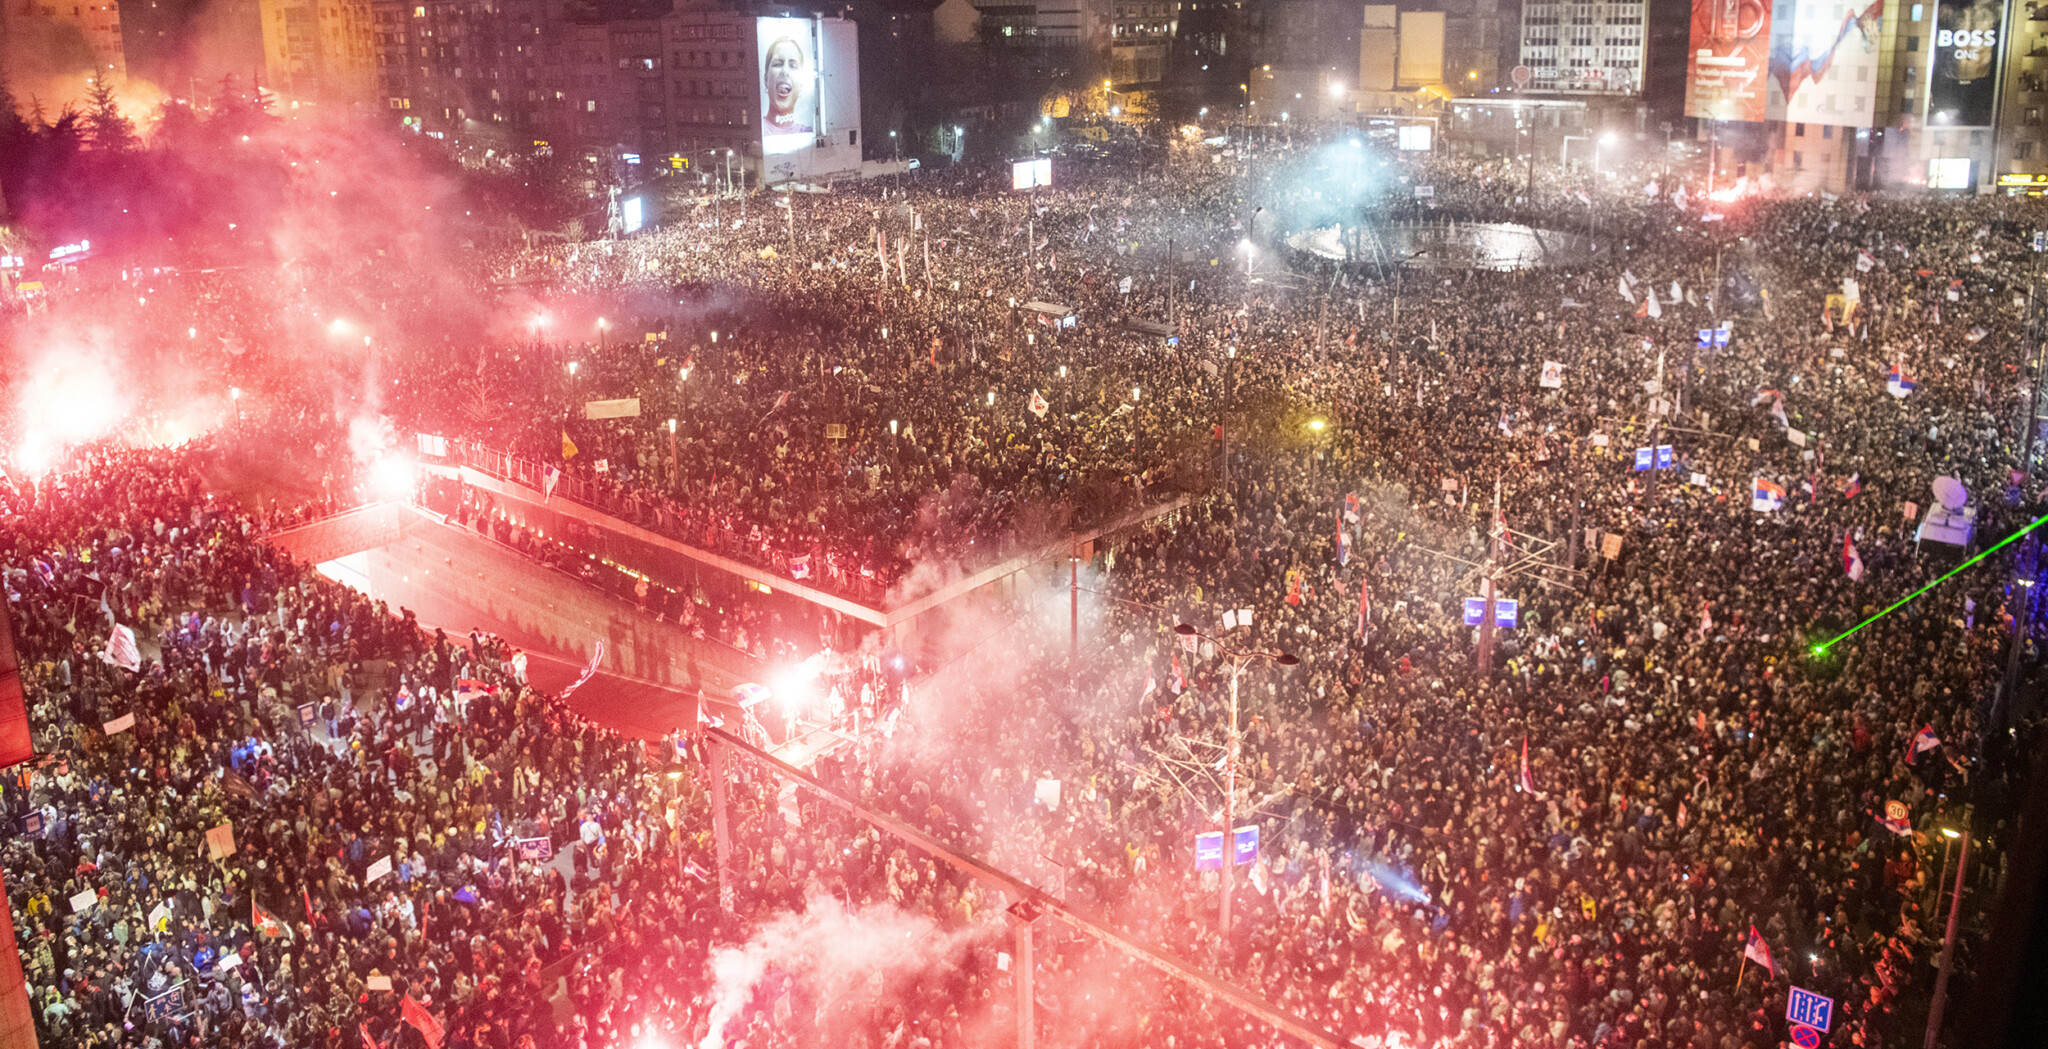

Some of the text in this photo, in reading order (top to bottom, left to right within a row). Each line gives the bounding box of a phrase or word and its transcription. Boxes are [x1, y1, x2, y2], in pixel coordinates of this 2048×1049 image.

[1937, 29, 1996, 47] BOSS
[1954, 49, 1979, 61] ONE
[1891, 805, 1904, 818] 30
